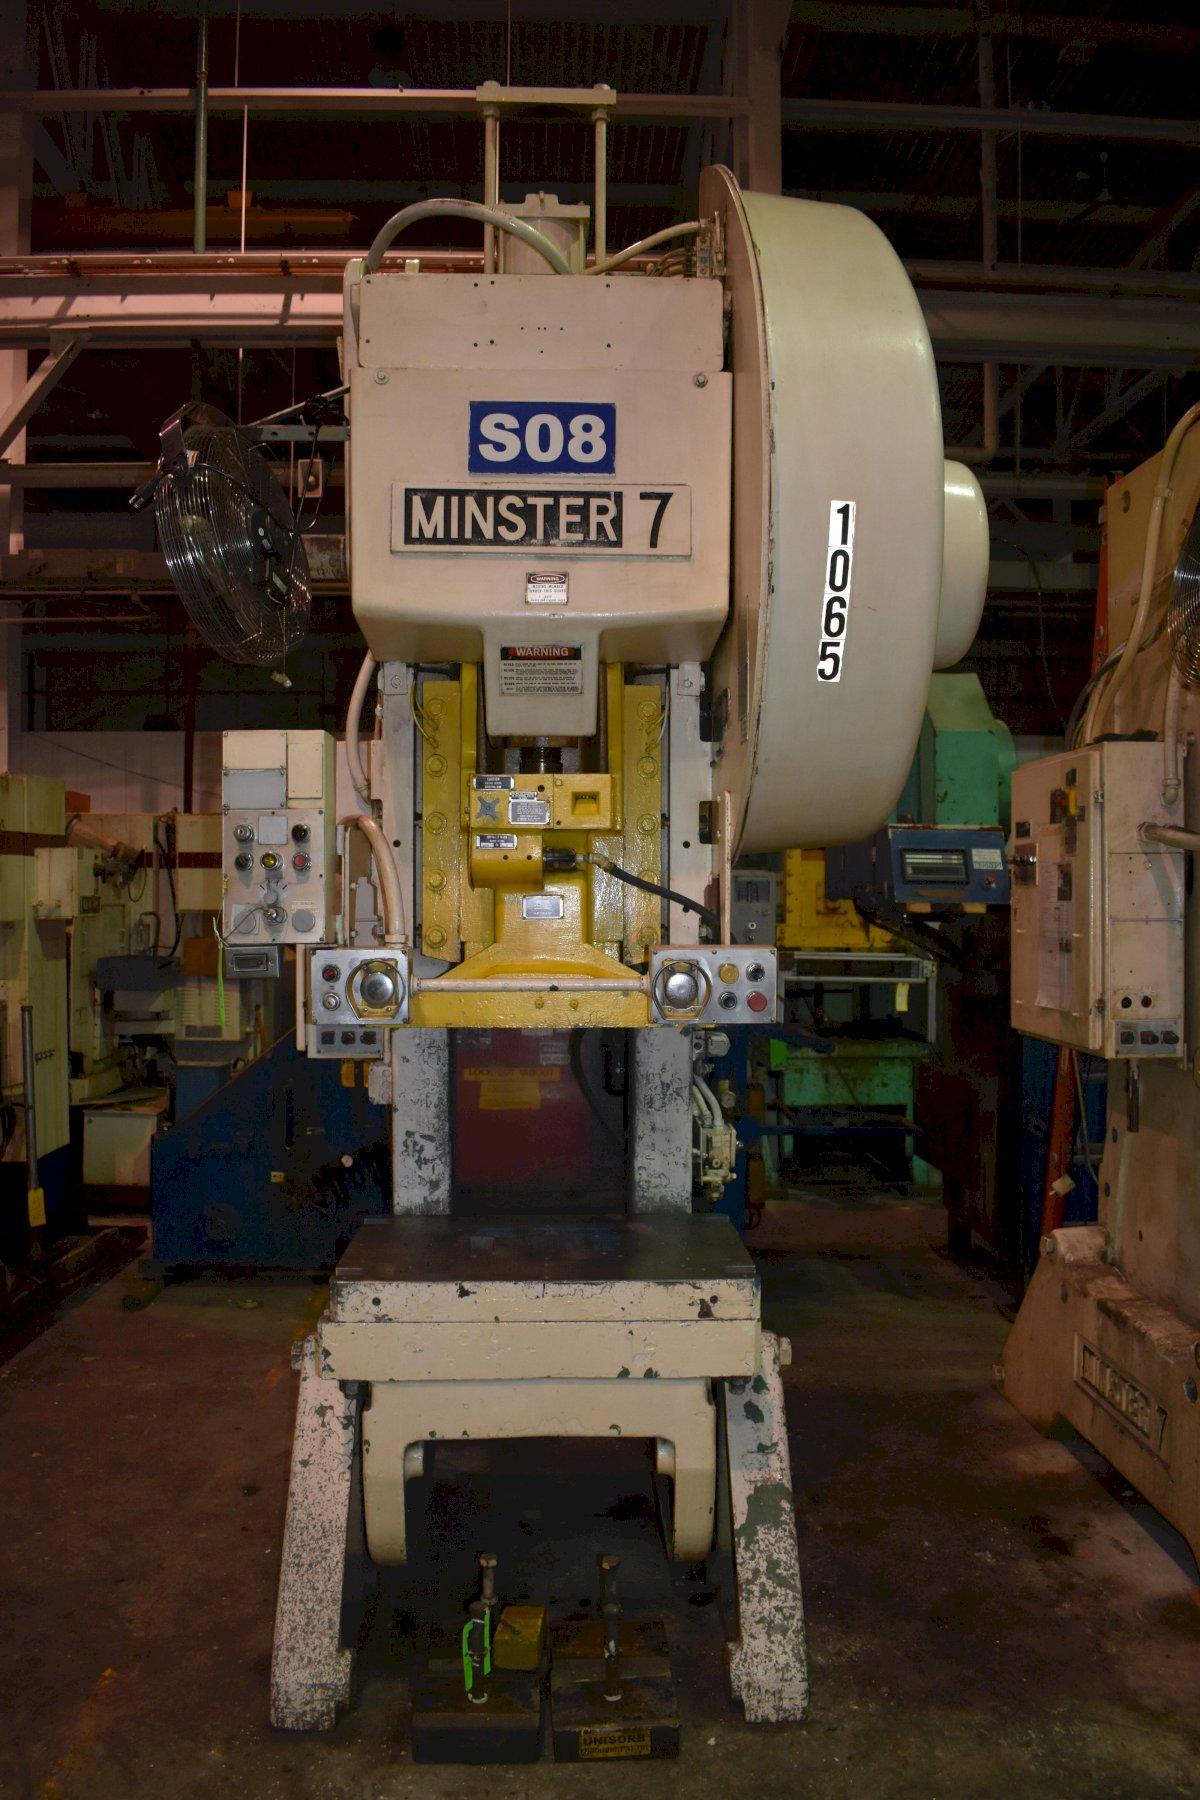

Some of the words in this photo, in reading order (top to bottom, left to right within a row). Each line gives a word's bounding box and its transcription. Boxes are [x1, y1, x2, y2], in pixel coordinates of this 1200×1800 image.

[478, 413, 607, 463] S08
[411, 494, 618, 542] MINSTER
[639, 492, 674, 549] 7
[817, 503, 850, 681] 1065
[516, 647, 569, 657] WARNING
[583, 1735, 645, 1745] UNISORB
